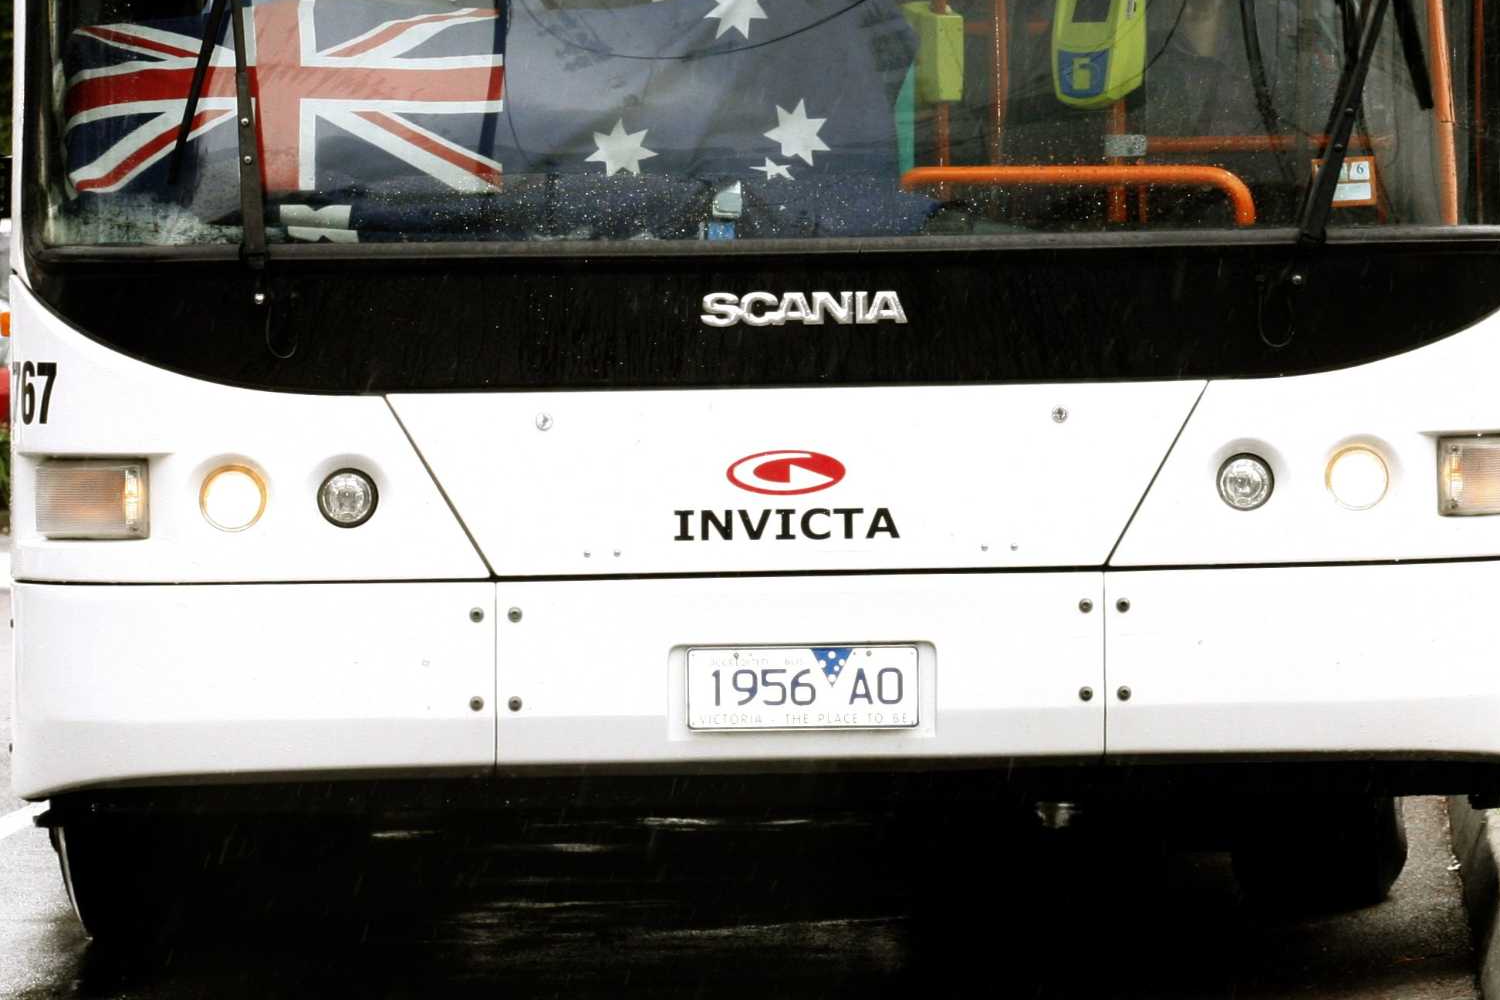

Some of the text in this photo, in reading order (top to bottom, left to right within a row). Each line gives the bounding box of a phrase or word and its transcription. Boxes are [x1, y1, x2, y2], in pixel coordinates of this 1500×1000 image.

[700, 290, 908, 327] SCANIA
[673, 507, 900, 541] INVICTA
[711, 667, 904, 706] 1956 AO
[785, 712, 809, 724] THE
[818, 712, 858, 724] PLACE
[867, 712, 883, 724] TO
[892, 711, 908, 723] BE
